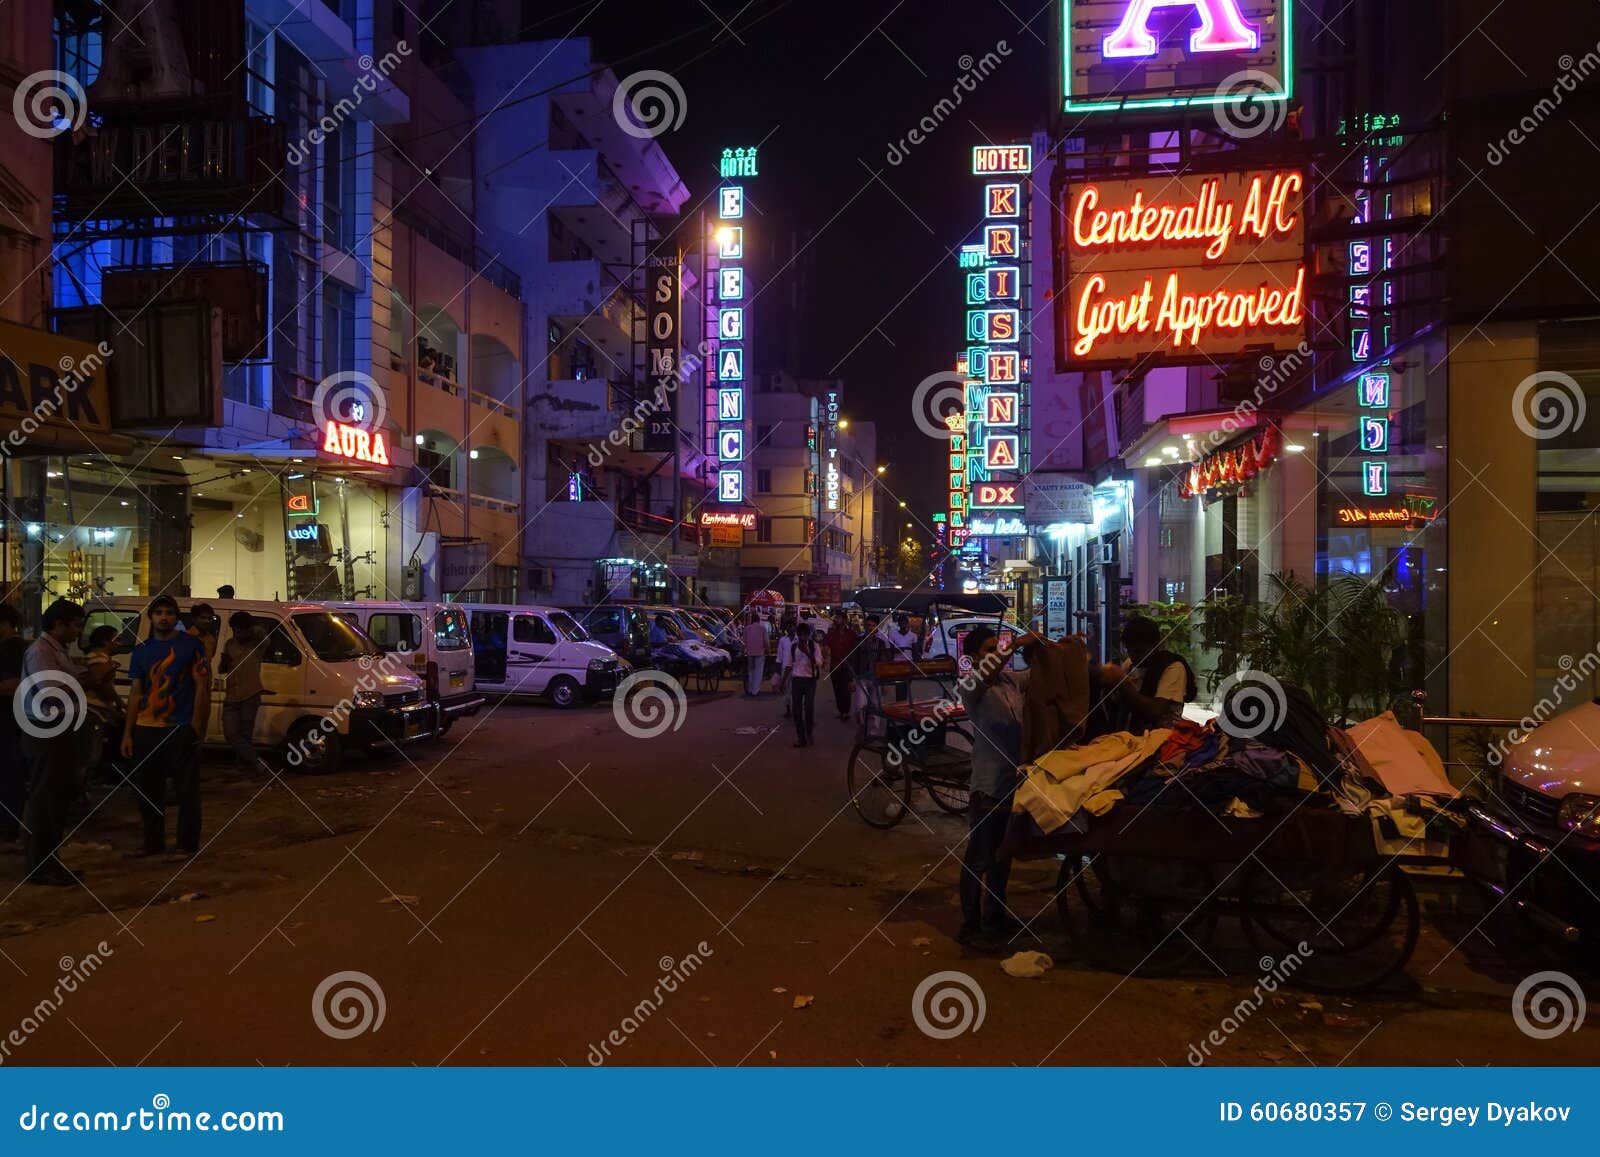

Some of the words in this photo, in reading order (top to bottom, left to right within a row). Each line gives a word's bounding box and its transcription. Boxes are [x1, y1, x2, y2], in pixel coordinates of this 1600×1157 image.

[720, 156, 759, 178] HOTEL
[976, 149, 1028, 171] HOTEL
[1073, 174, 1232, 259] Centerally
[1240, 173, 1302, 238] A/C
[960, 251, 998, 268] HOT
[989, 188, 1015, 465] KRISHNA
[1074, 273, 1154, 356] Govt
[1154, 269, 1304, 347] Approved
[651, 275, 674, 413] SOMA
[720, 188, 743, 502] ELEGANCE
[970, 276, 990, 482] GODWIN
[323, 420, 389, 466] AURA
[652, 422, 672, 435] DX
[827, 463, 838, 510] LODGE
[980, 486, 1016, 503] DX
[971, 519, 995, 535] New
